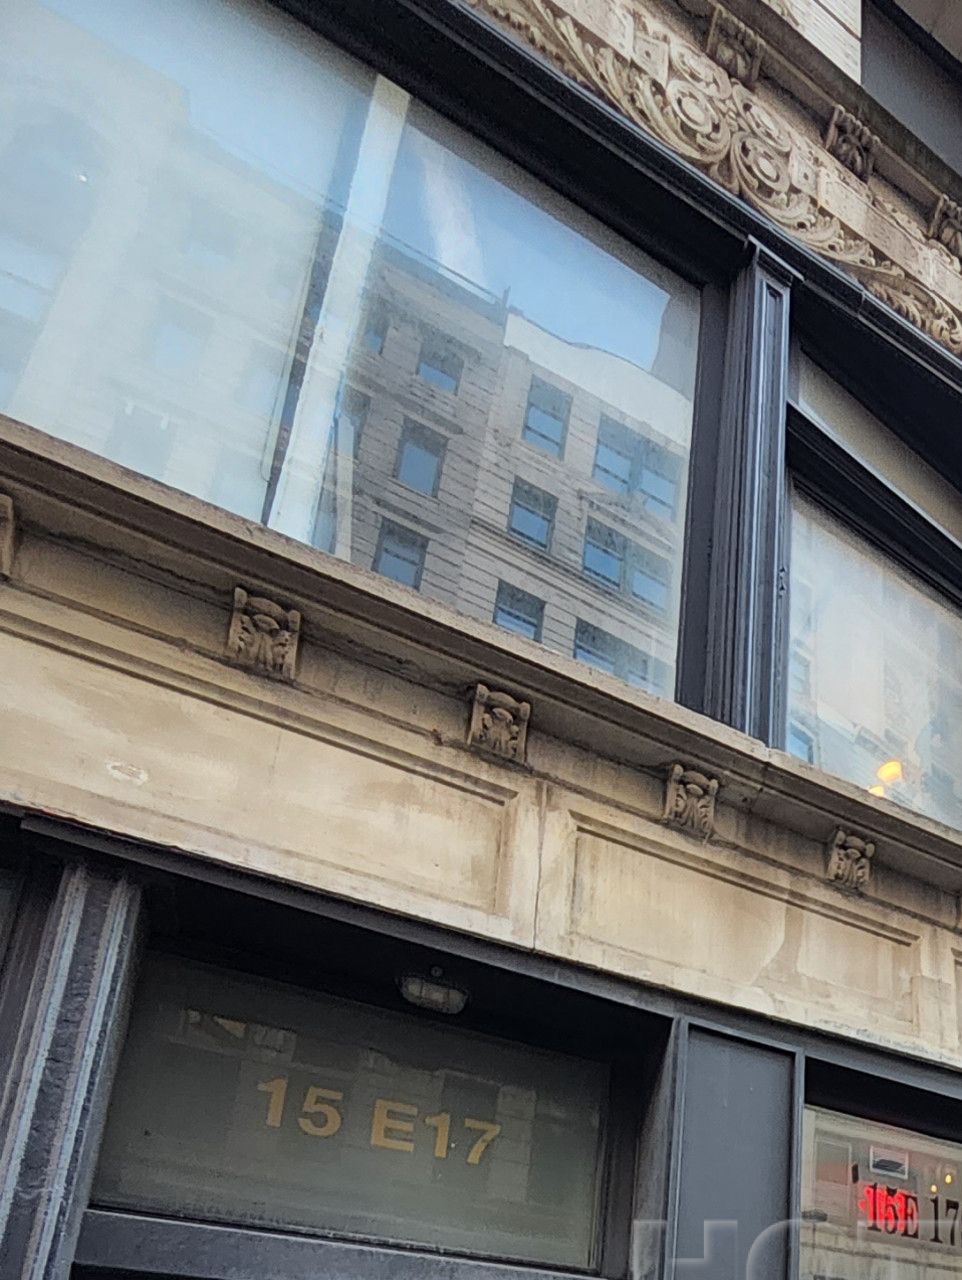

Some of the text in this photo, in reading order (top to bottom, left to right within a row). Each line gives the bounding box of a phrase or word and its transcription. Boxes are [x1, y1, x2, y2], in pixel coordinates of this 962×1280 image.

[257, 1076, 501, 1165] 15 E17
[866, 1182, 919, 1239] 15E
